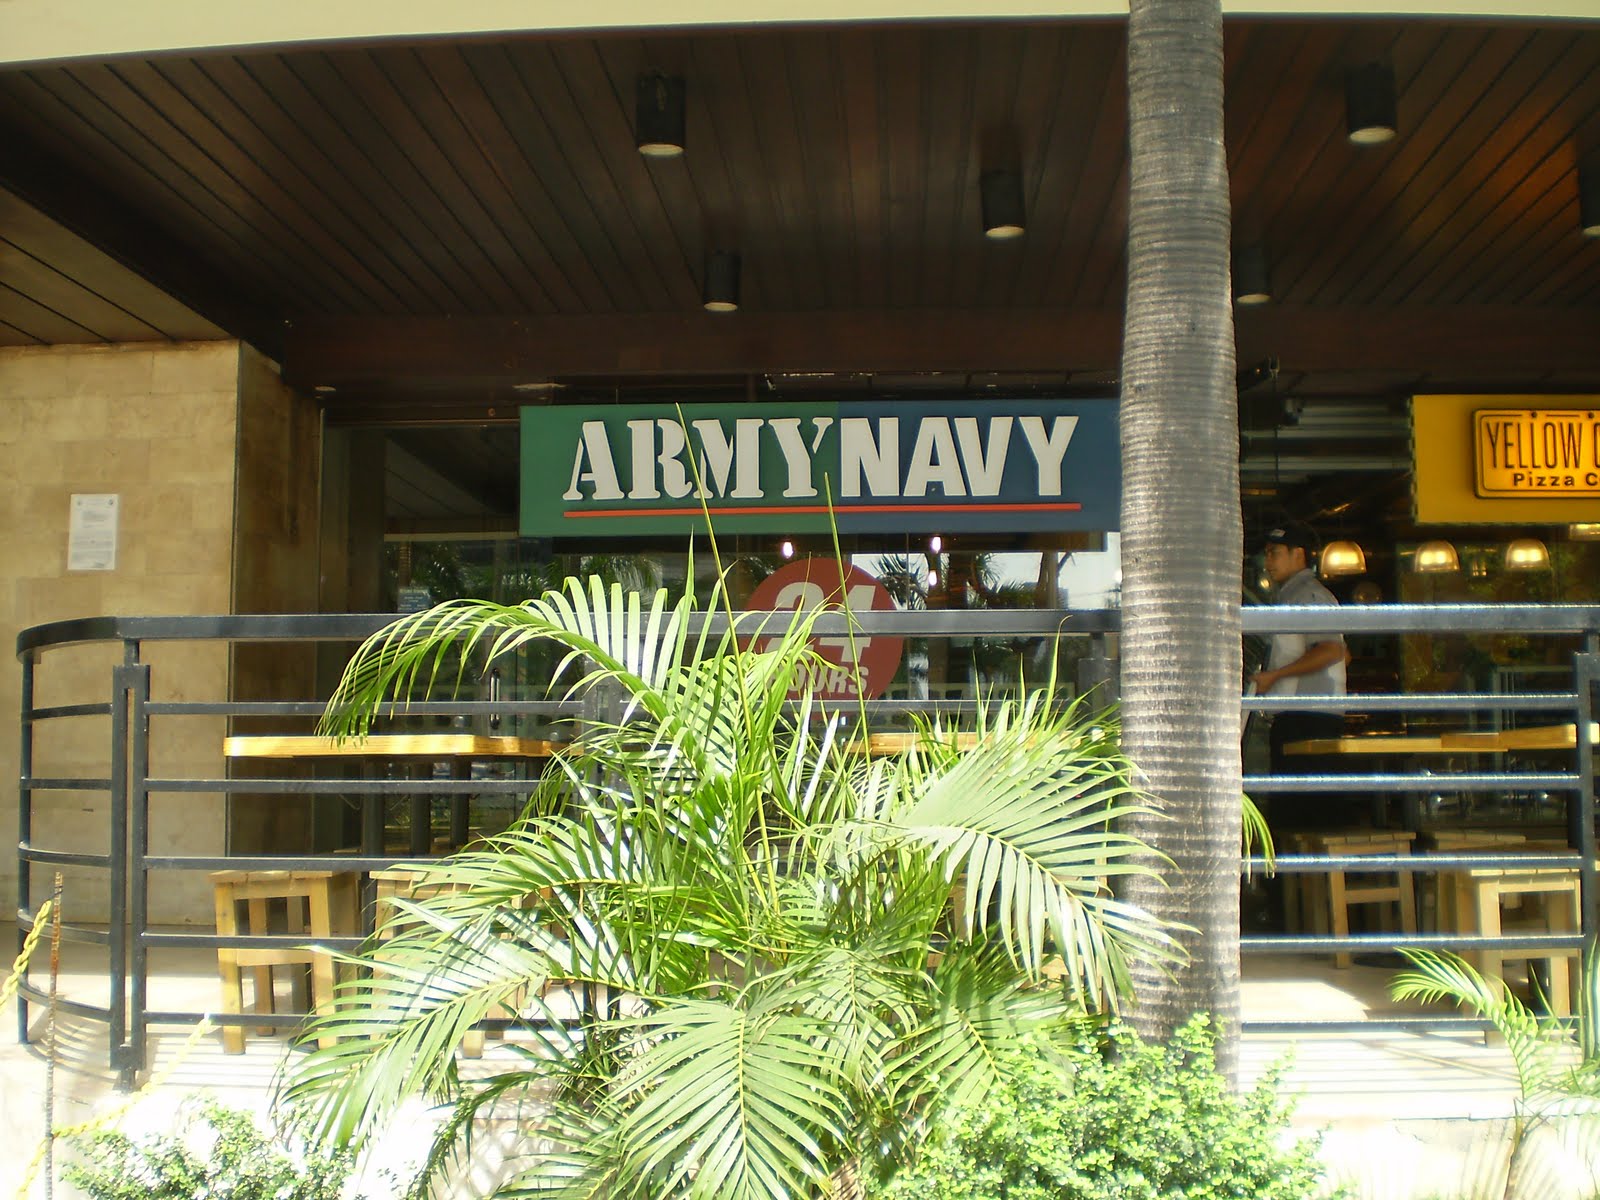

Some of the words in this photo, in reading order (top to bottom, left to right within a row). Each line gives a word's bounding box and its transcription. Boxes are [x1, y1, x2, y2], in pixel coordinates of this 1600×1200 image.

[1486, 422, 1583, 469] YELLOW
[1513, 471, 1575, 487] Pizza
[764, 664, 869, 694] OURS
